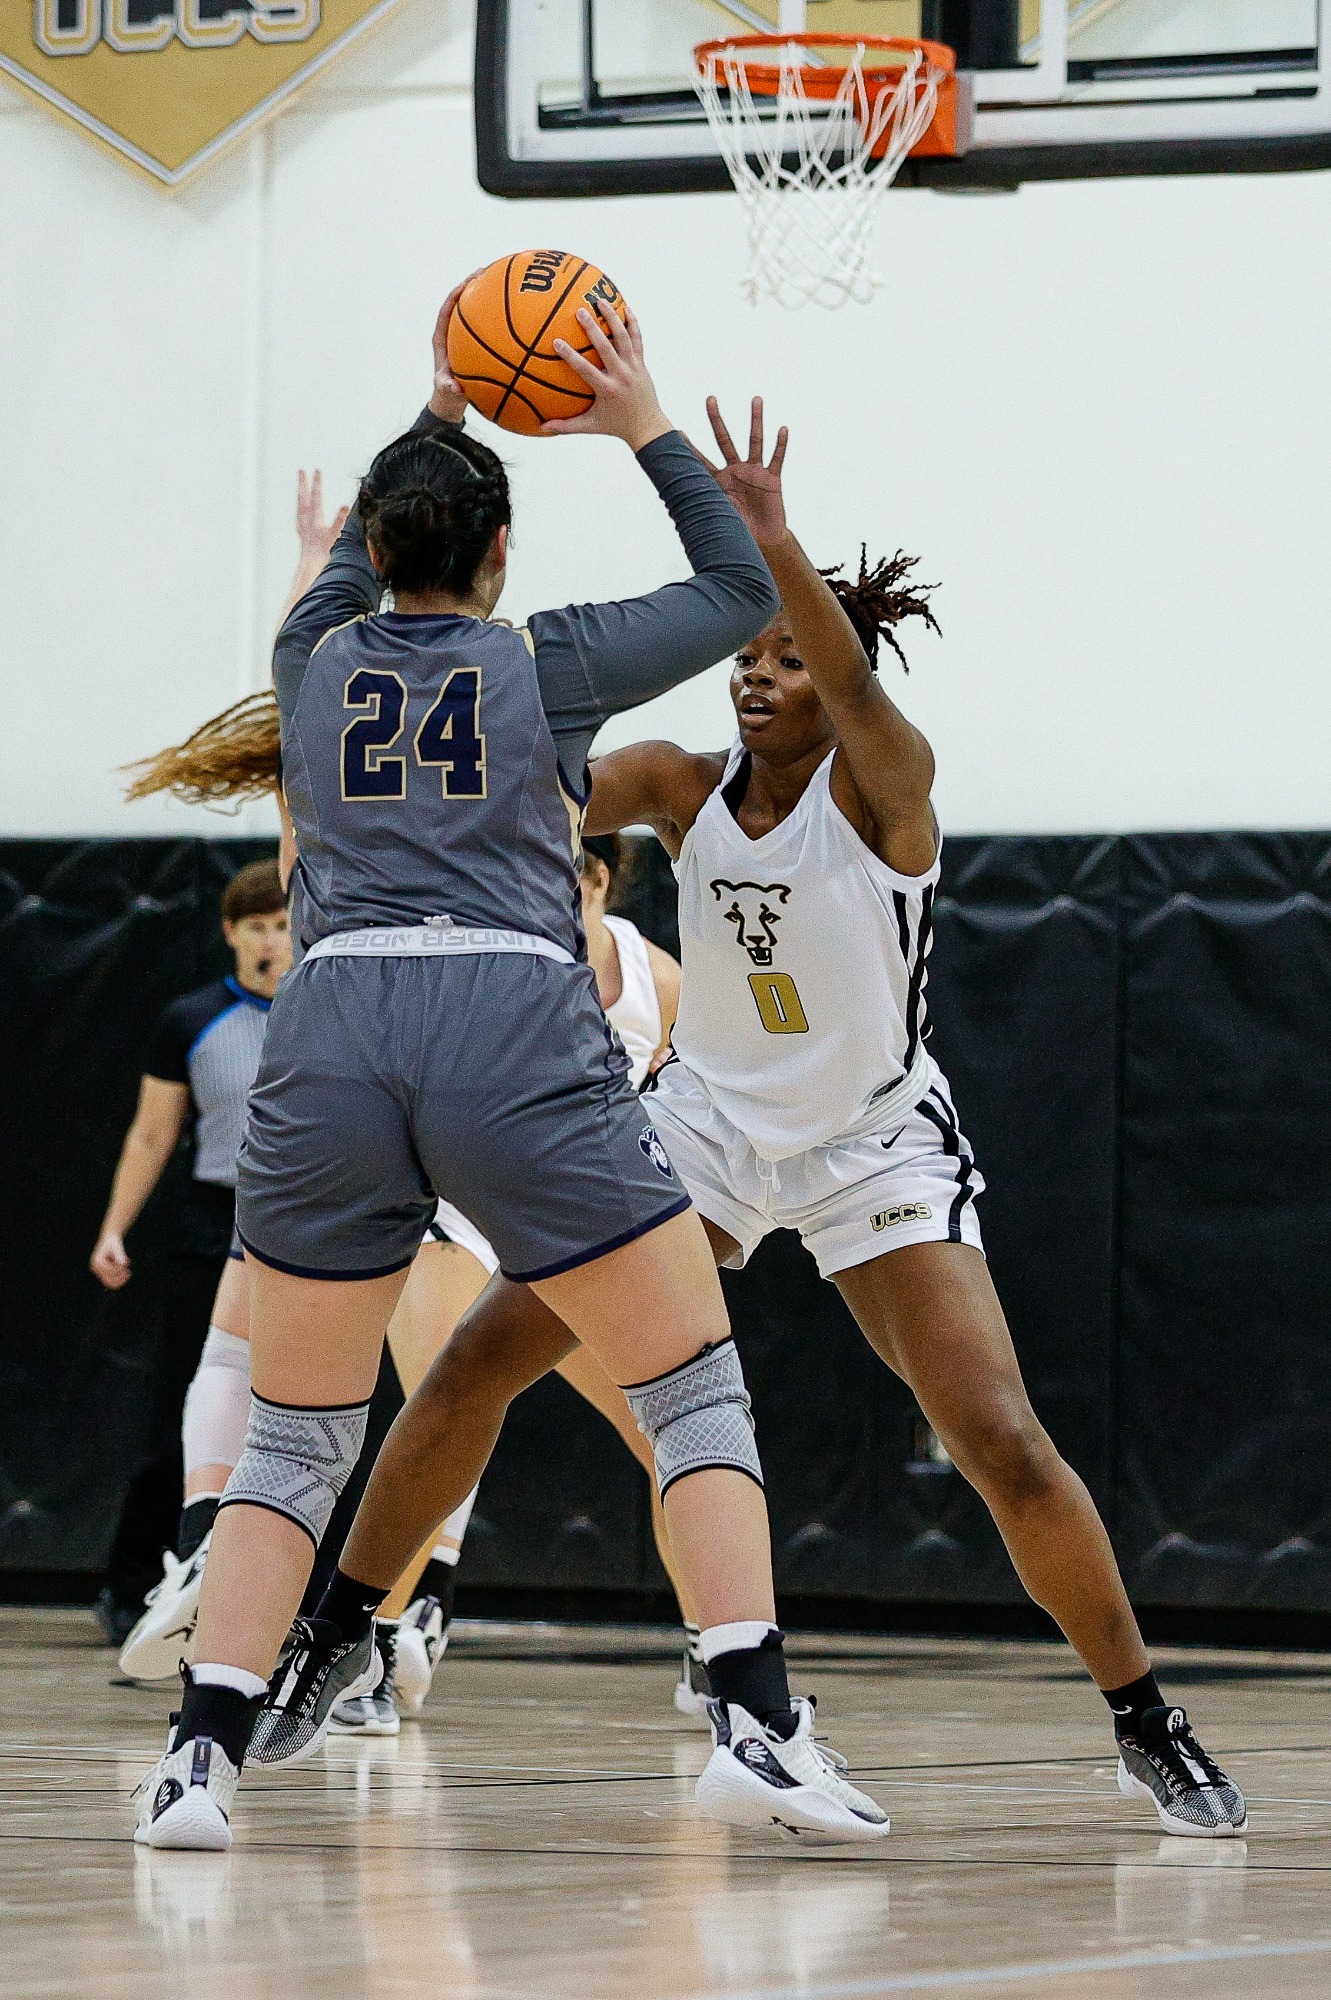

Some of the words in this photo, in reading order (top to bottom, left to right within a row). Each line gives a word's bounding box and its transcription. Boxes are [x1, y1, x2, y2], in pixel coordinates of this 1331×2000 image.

[519, 250, 567, 293] Wil
[583, 273, 620, 318] NC
[340, 667, 487, 801] 24
[747, 972, 809, 1034] 0
[869, 1202, 932, 1232] UCCS
